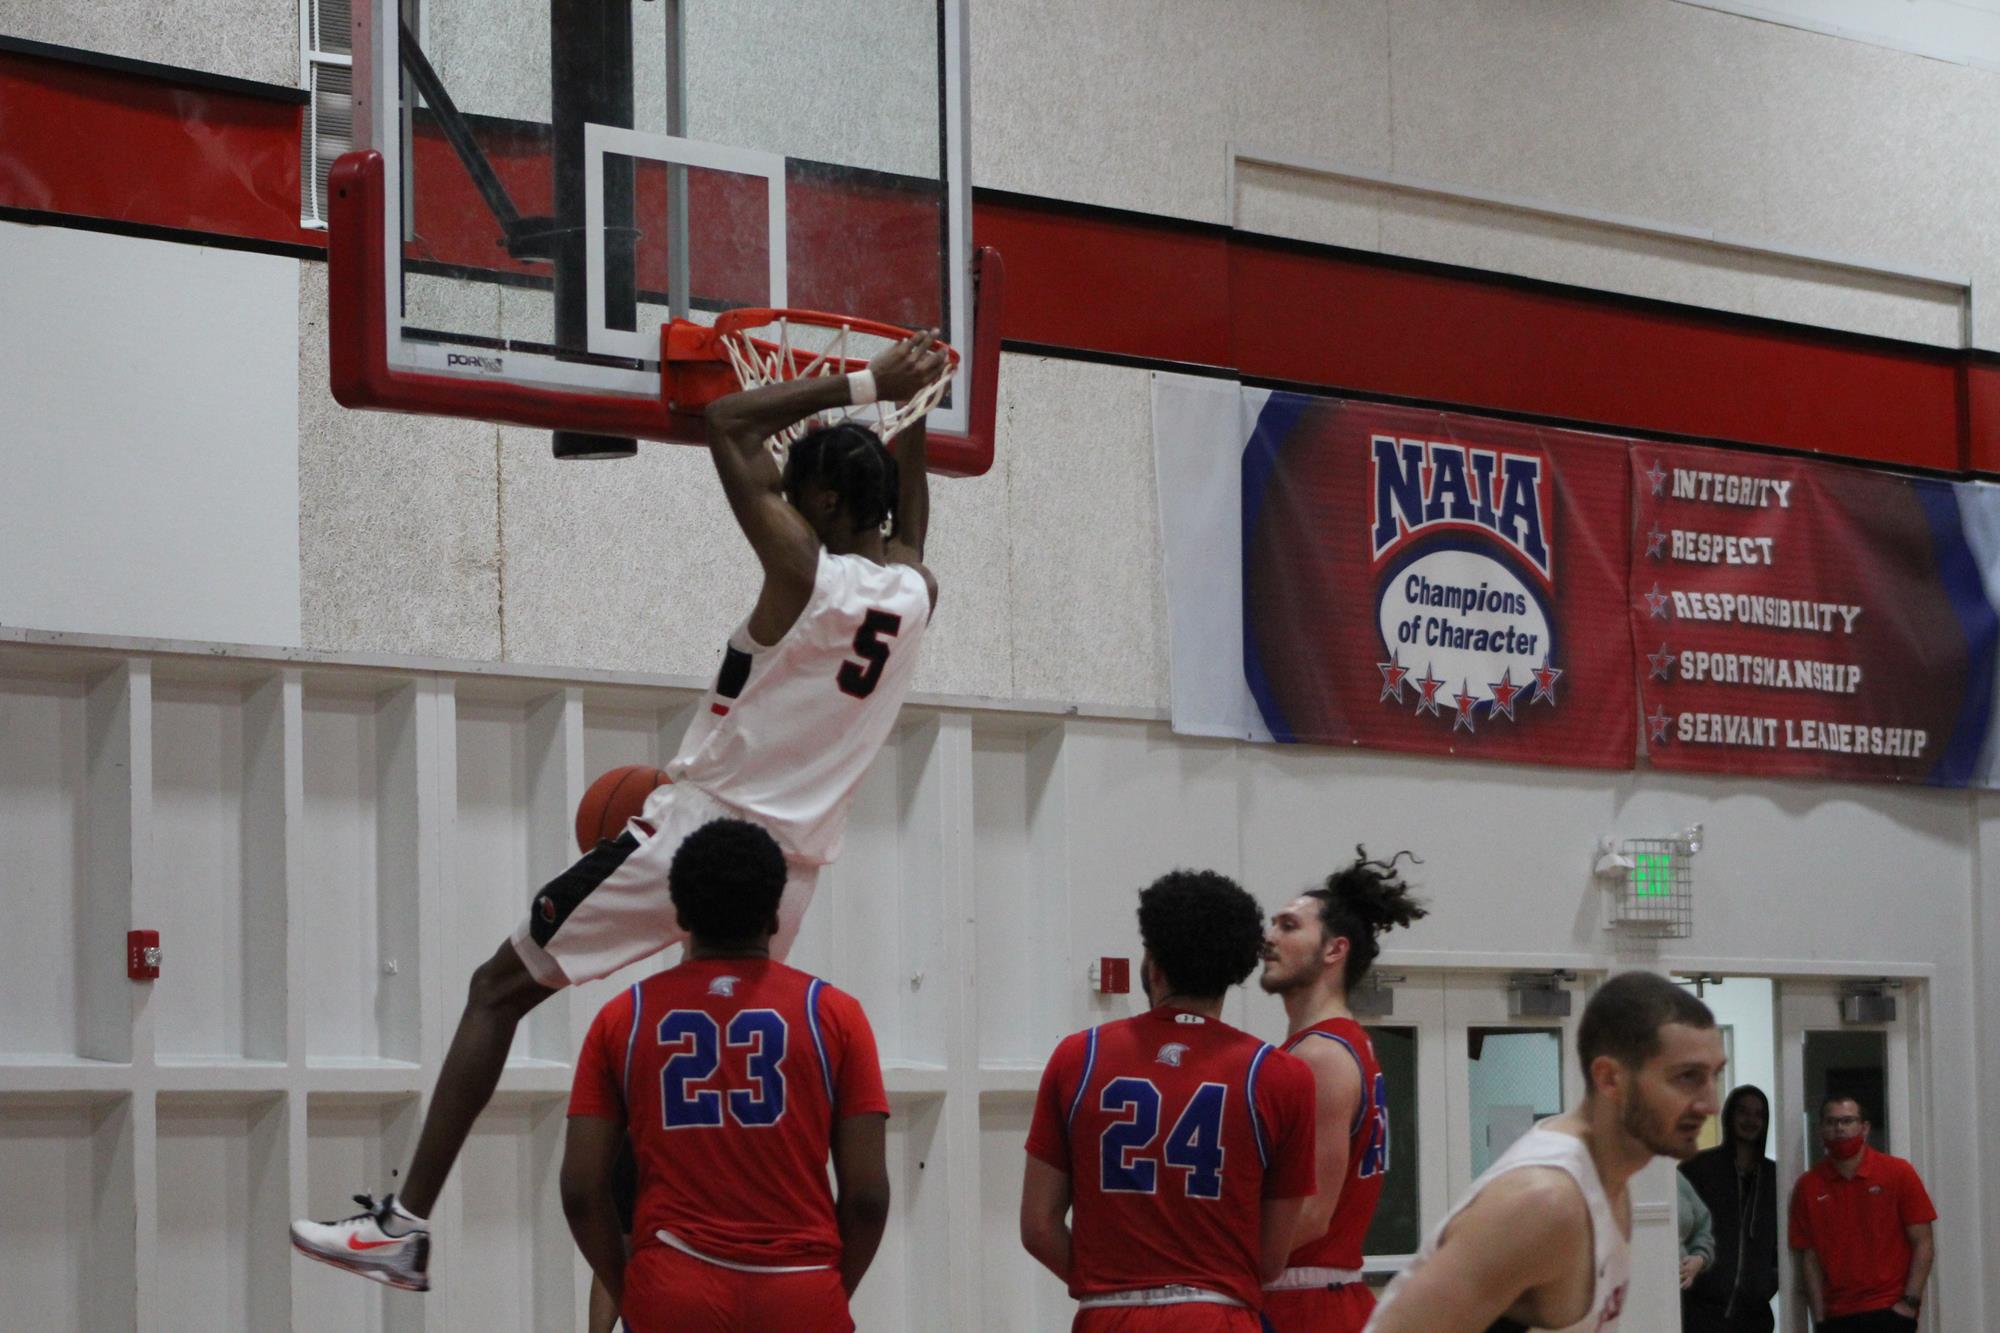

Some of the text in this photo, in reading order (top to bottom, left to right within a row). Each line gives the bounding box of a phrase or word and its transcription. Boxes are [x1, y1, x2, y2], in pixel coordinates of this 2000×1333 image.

[1371, 434, 1551, 582] NAIA
[1672, 468, 1792, 508] INTEGRITY
[1671, 530, 1774, 565] RESPECT
[1405, 573, 1526, 617] Champions
[1671, 591, 1862, 634] RESPONSIBILITY
[835, 607, 903, 700] 5
[1397, 614, 1537, 656] of Character
[1680, 650, 1861, 693] SPORTSMANSHIP
[1677, 712, 1927, 758] SERVANT LEADERSHIP
[657, 1008, 788, 1130] 23
[1100, 1076, 1228, 1200] 24
